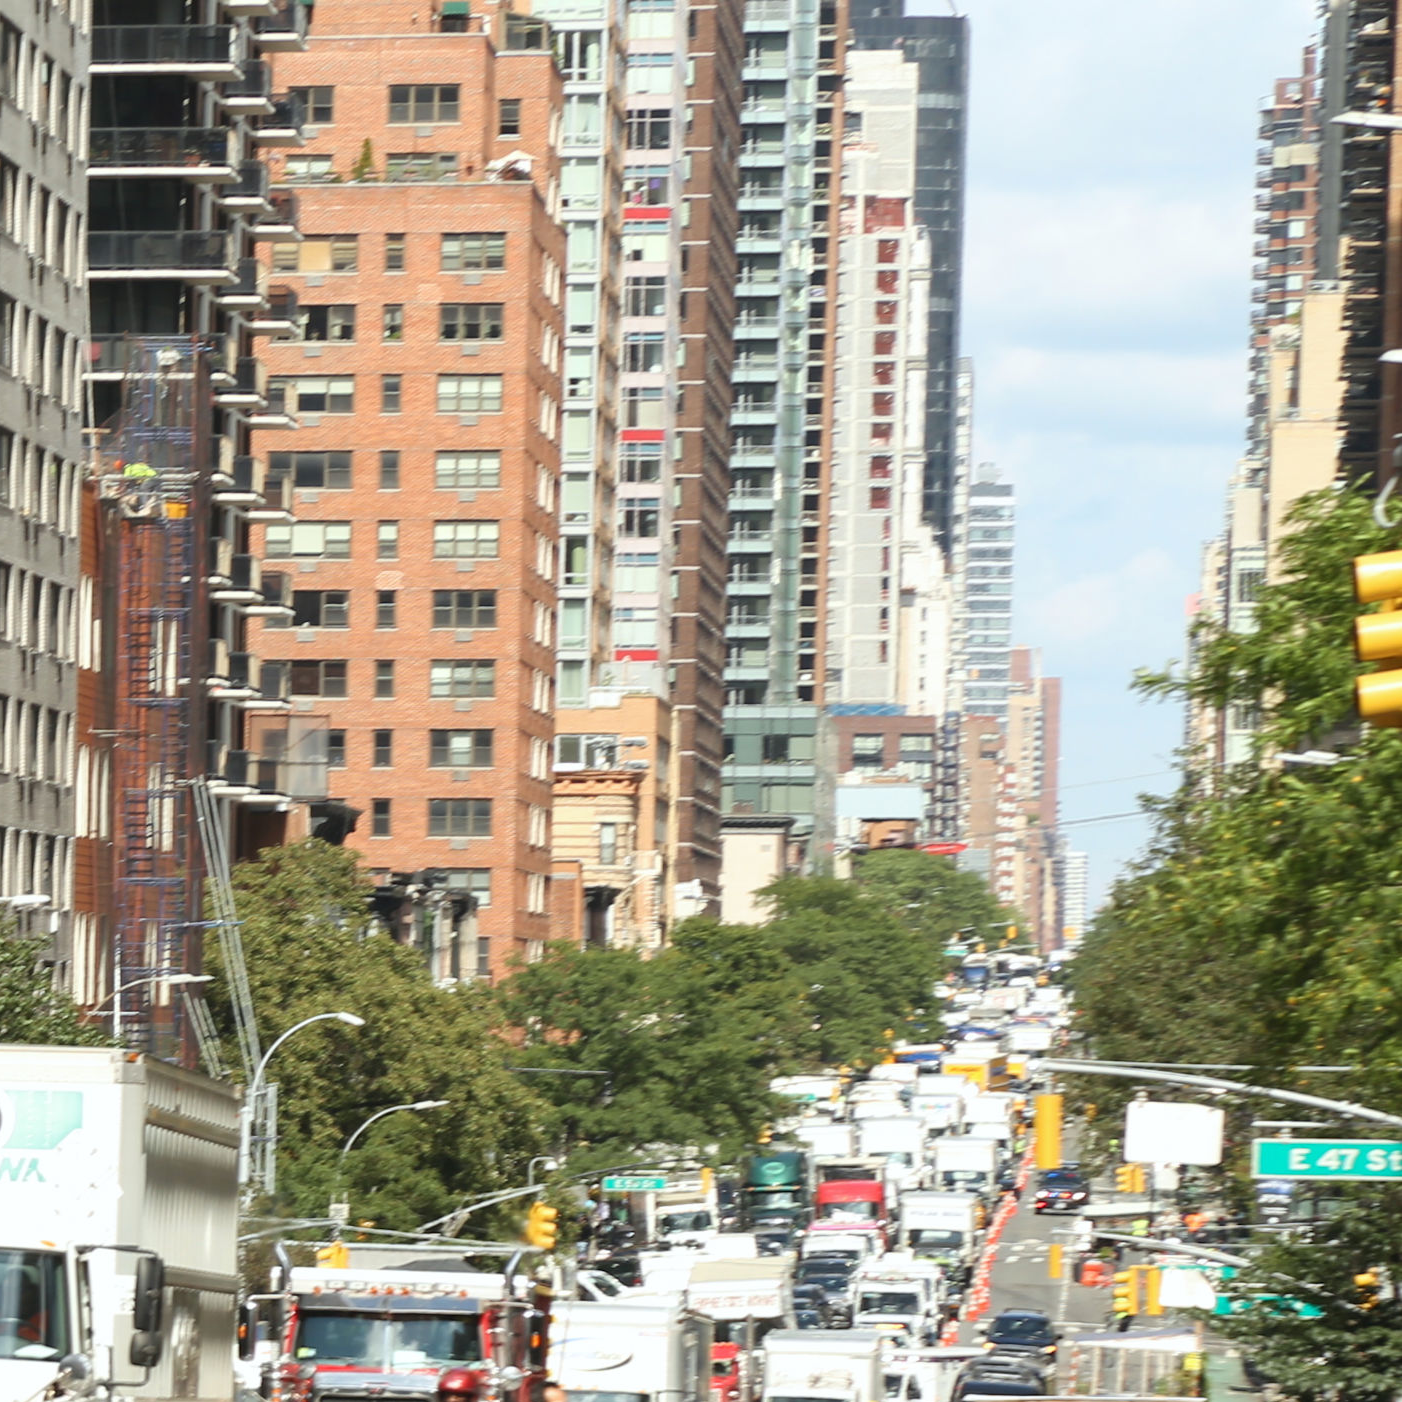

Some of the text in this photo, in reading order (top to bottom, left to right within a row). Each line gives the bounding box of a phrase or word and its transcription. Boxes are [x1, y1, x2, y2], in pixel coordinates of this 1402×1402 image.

[1289, 1148, 1402, 1171] E 47 St
